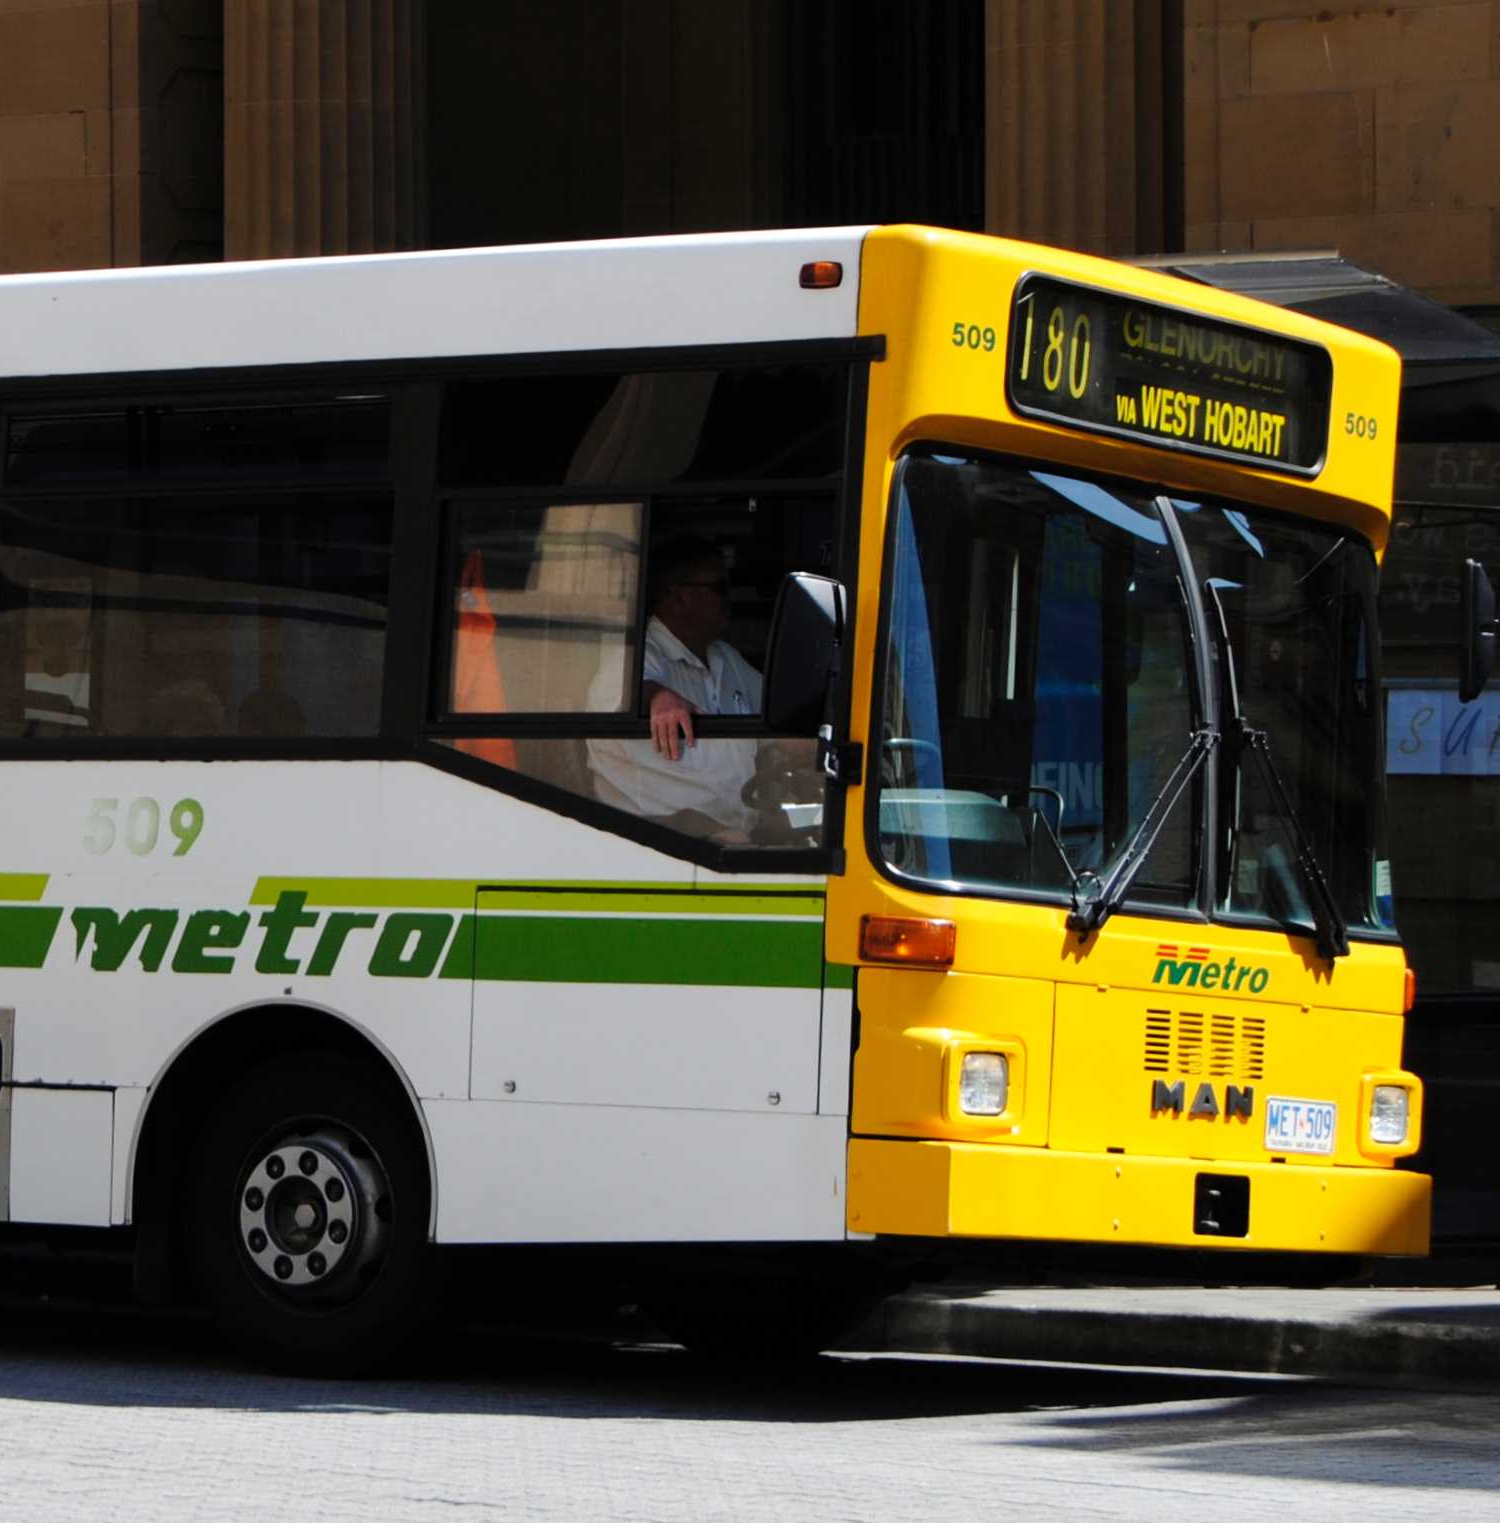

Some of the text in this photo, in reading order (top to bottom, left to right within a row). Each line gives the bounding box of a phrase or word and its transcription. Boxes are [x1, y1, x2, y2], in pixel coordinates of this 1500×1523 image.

[951, 322, 996, 352] 509
[1018, 295, 1092, 400] 180
[1122, 307, 1285, 381] GLENORCHY
[1116, 384, 1286, 458] VIA WEST HOBART
[1344, 412, 1378, 441] 509
[82, 796, 205, 857] 509
[1152, 944, 1270, 994] Metro
[1151, 1078, 1254, 1119] MAN
